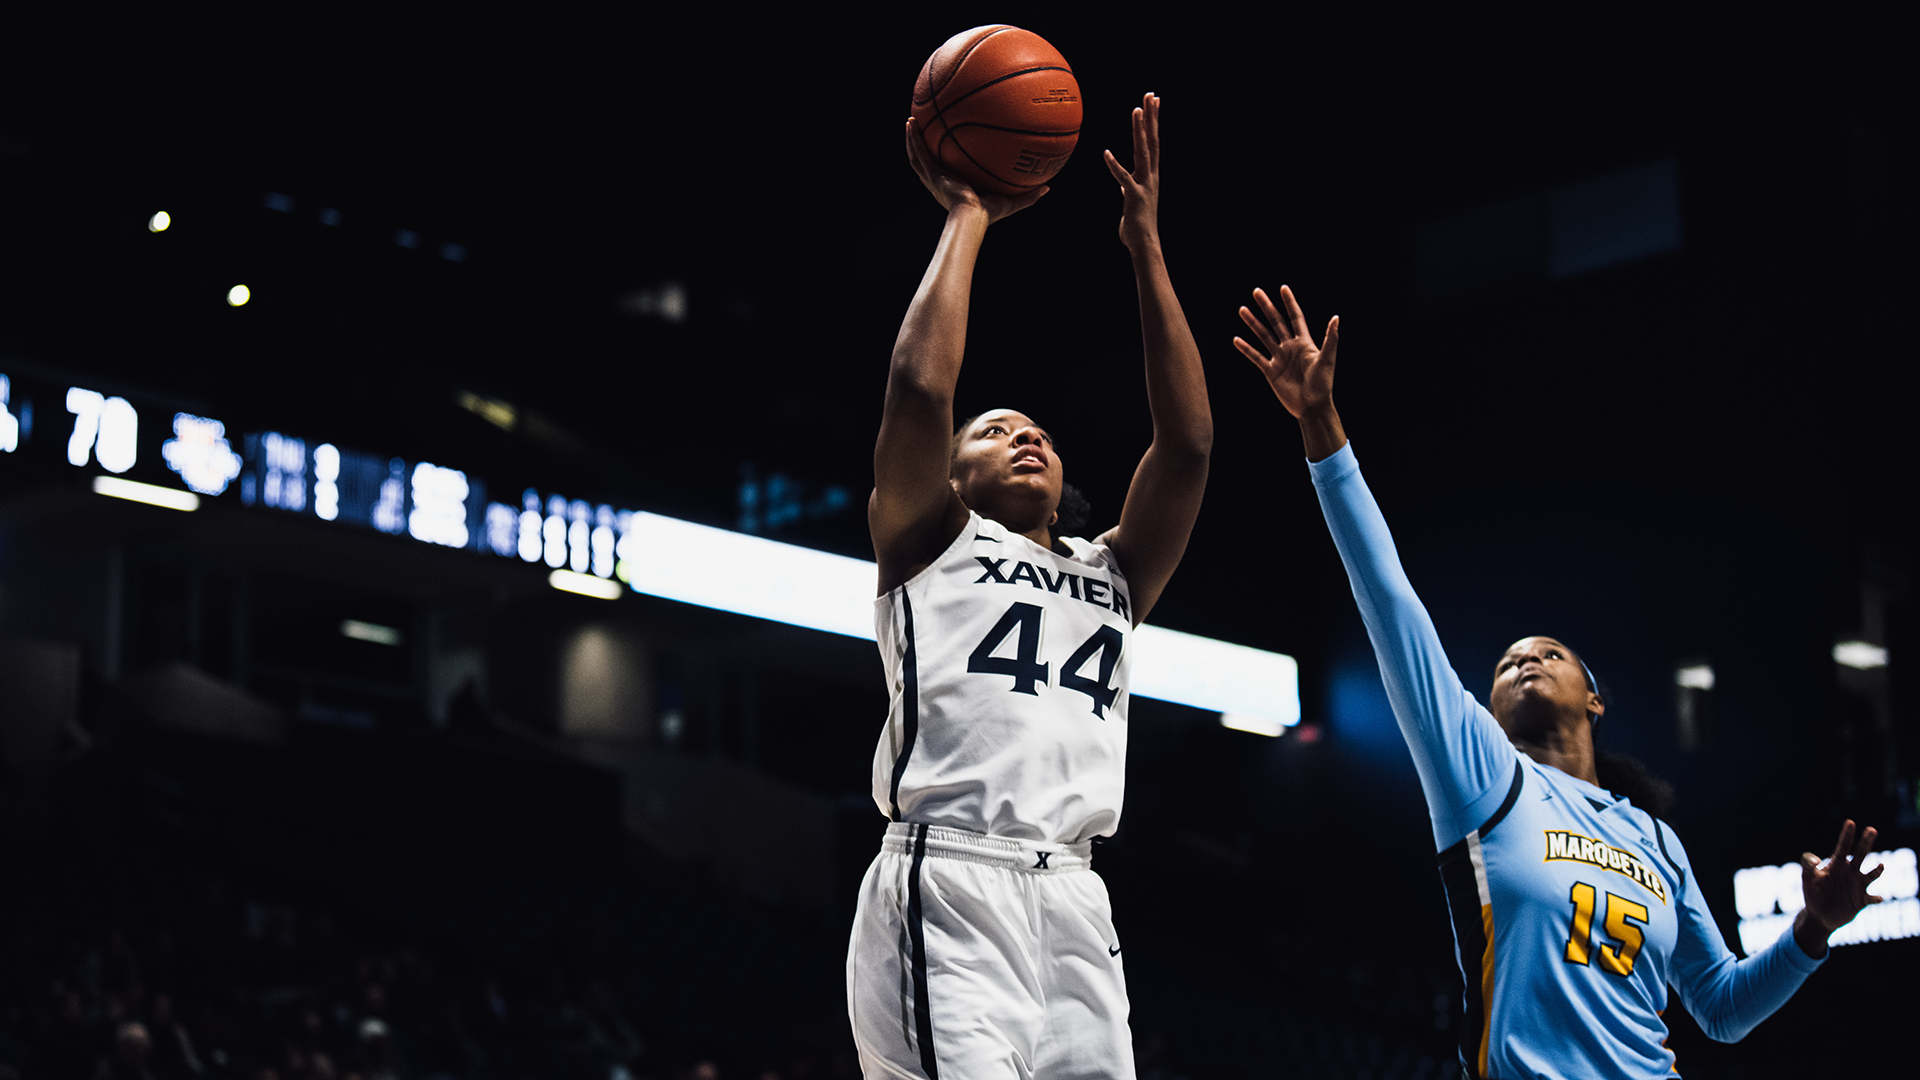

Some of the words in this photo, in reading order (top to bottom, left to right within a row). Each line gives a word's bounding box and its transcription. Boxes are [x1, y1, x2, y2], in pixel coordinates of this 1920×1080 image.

[66, 386, 138, 474] 70
[973, 556, 1130, 625] XAVIER
[967, 601, 1123, 722] 44
[1033, 850, 1051, 870] X
[1544, 830, 1667, 904] MARQUETTE
[1563, 881, 1650, 978] 15
